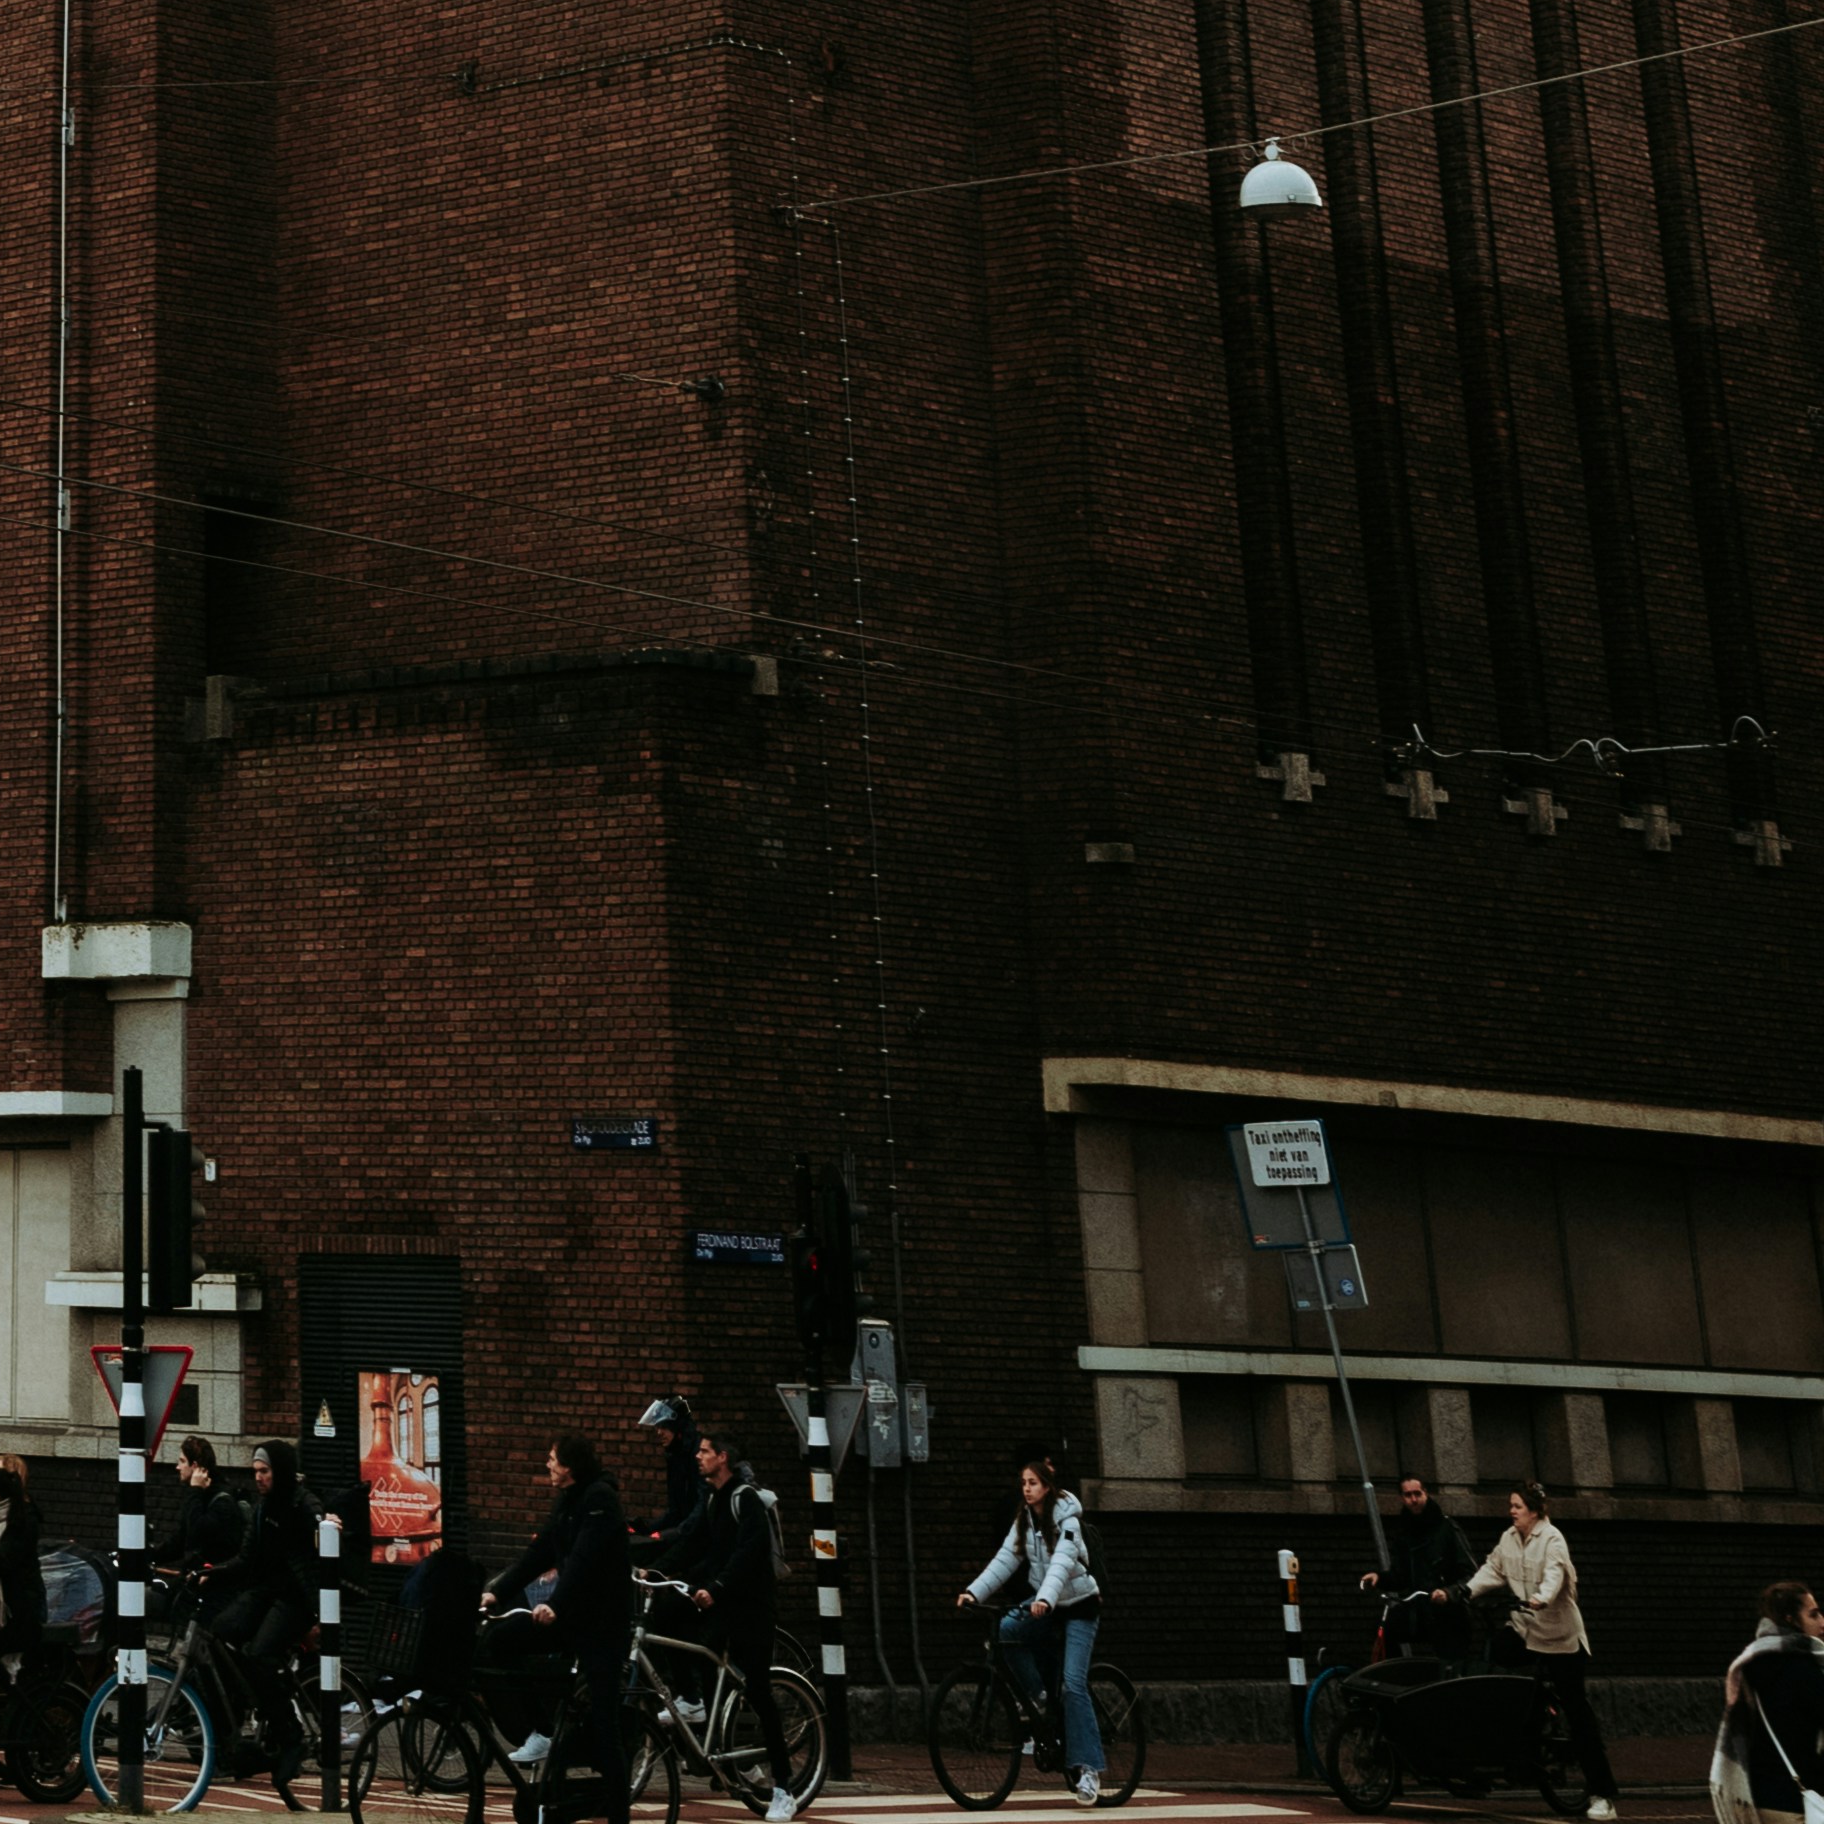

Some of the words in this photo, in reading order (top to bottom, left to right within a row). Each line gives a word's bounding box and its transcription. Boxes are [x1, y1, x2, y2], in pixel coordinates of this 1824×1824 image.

[1248, 1130, 1270, 1145] Taxi
[1272, 1128, 1321, 1147] ontheffing
[1269, 1147, 1288, 1162] niet
[1290, 1150, 1310, 1162] van
[1266, 1165, 1318, 1182] toepassing
[697, 1233, 739, 1249] FERDINAND
[740, 1235, 782, 1252] BOLSTRAAT
